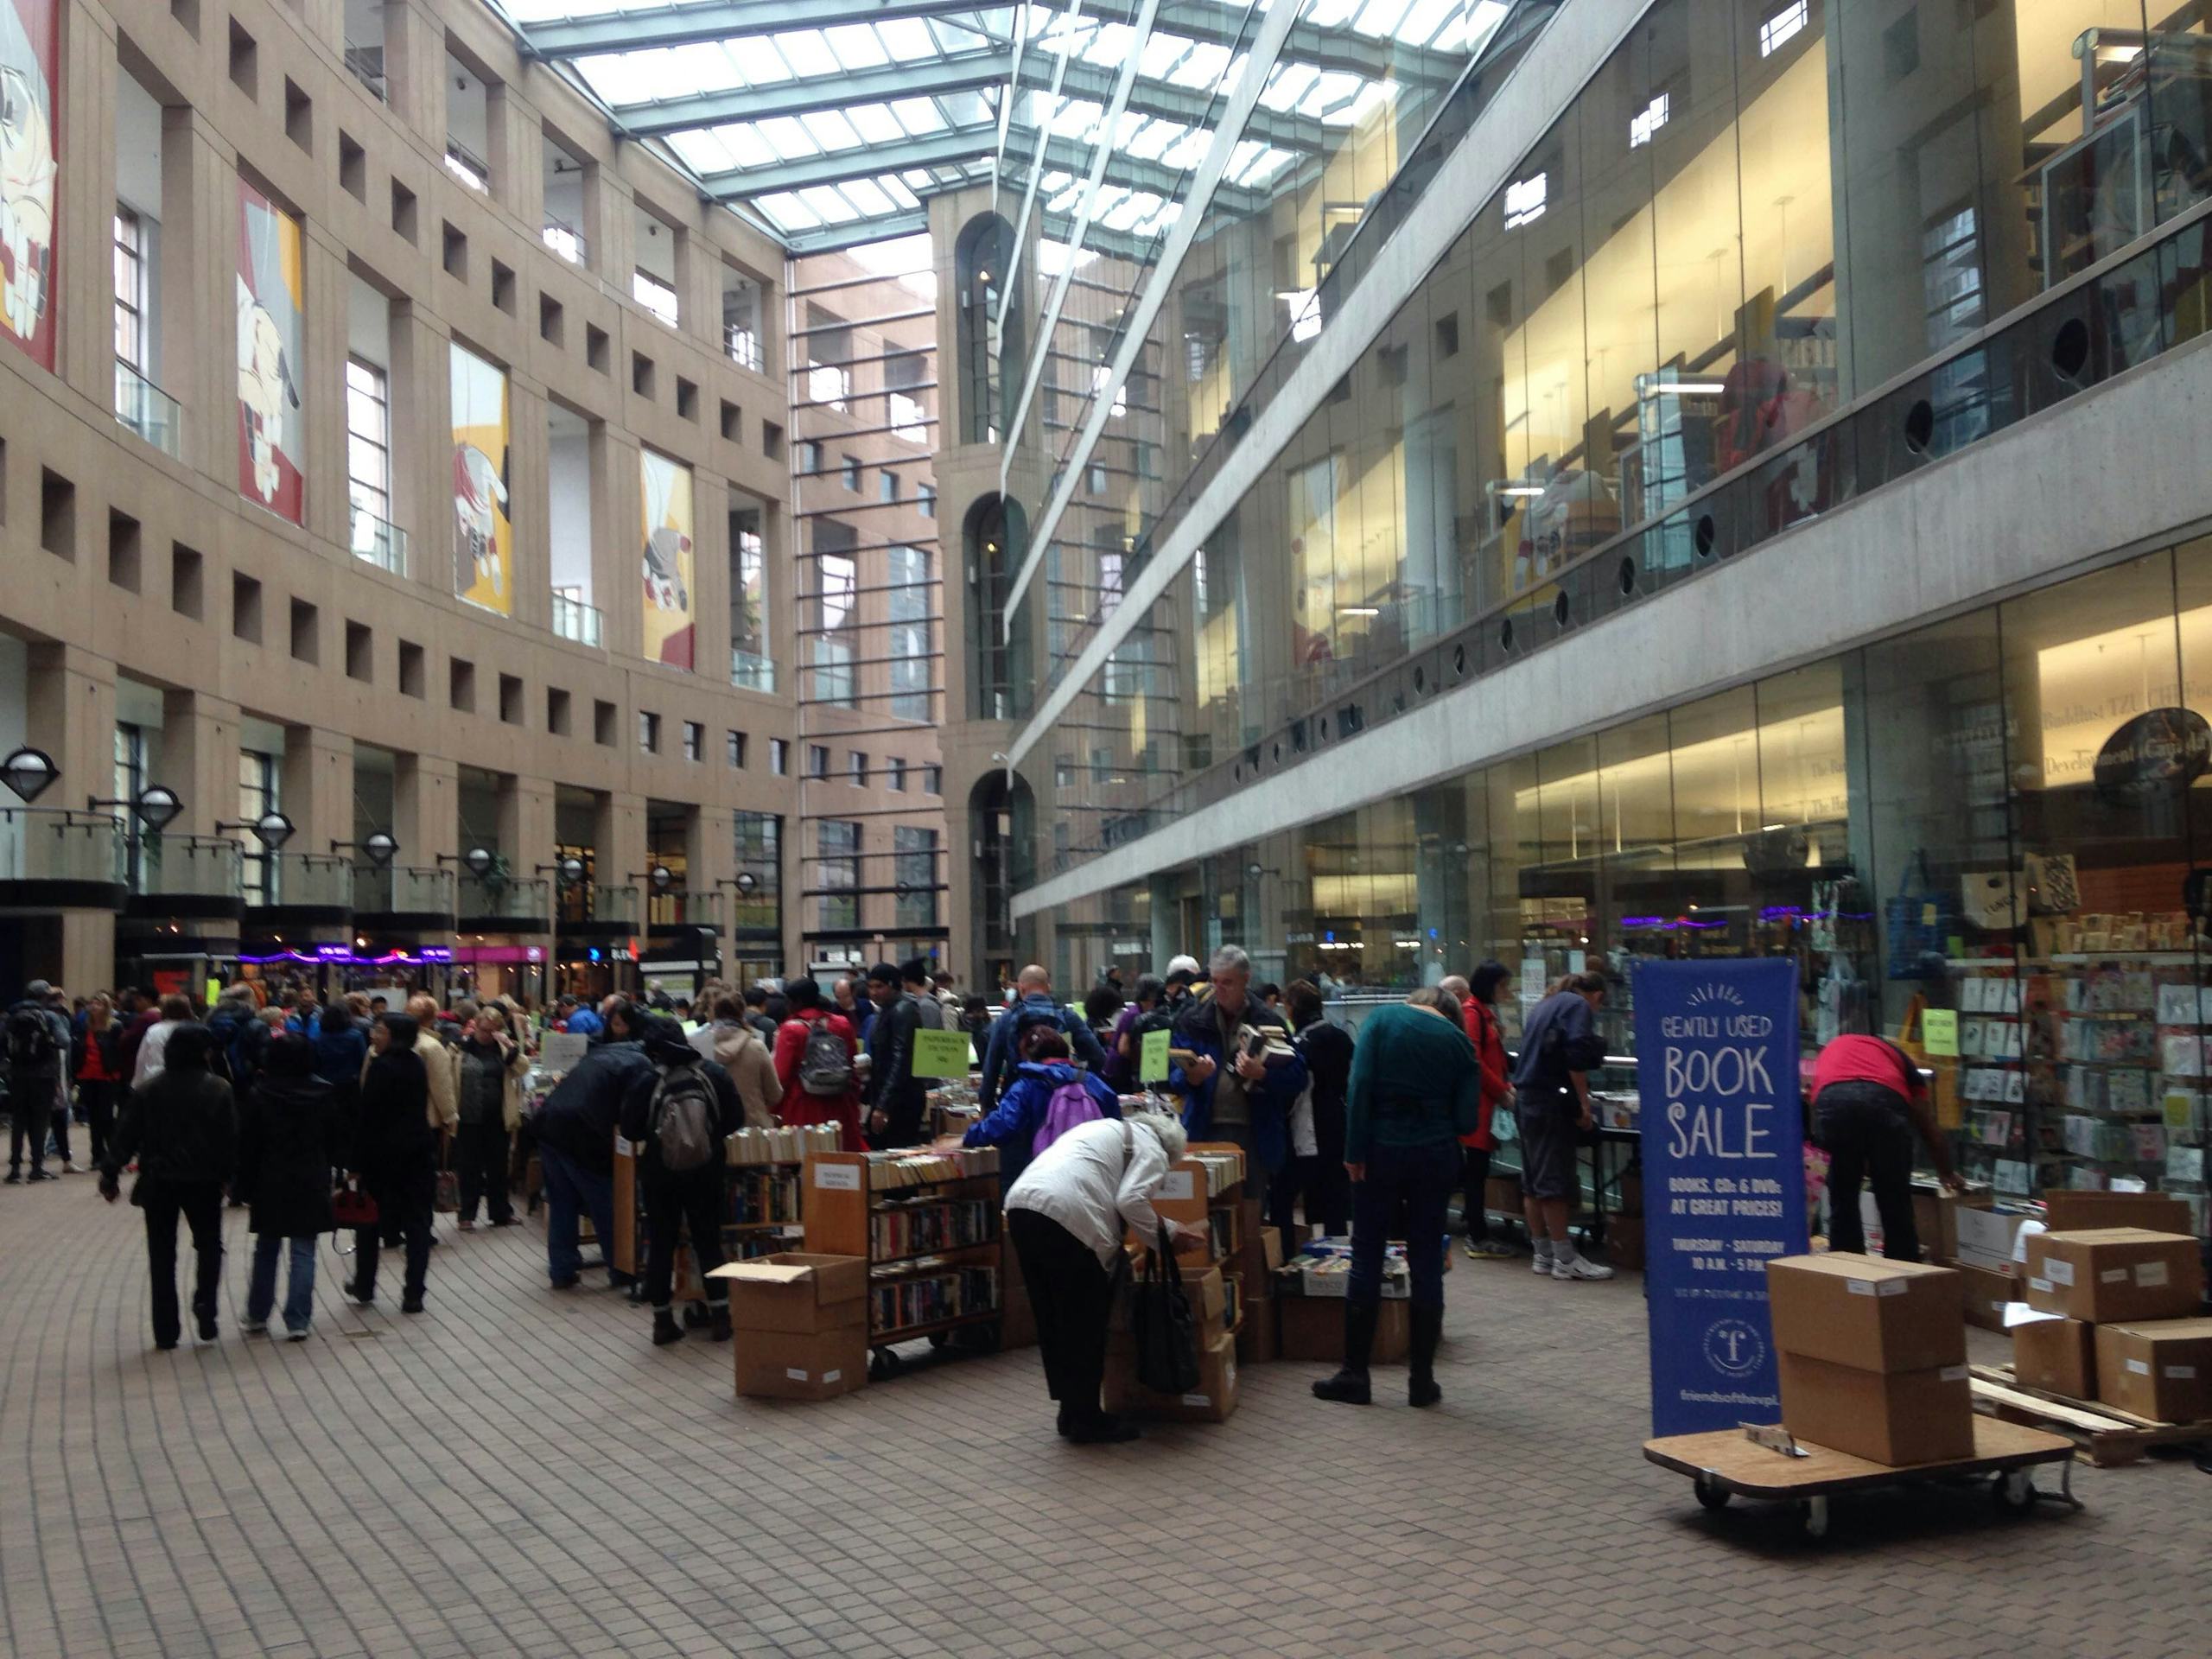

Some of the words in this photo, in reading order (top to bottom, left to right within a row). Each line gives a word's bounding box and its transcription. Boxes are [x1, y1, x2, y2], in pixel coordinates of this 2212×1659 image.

[1662, 1016, 1718, 1038] GENTLY
[1726, 1015, 1773, 1037] USED
[1665, 1046, 1775, 1098] BOOK
[1667, 1103, 1778, 1159] SALE
[1739, 1179, 1749, 1193] &
[1671, 1198, 1687, 1215] AT
[1689, 1198, 1729, 1216] GREAT
[1732, 1199, 1783, 1217] PRICES!
[1732, 1239, 1785, 1254] SATURDAY
[1680, 1389, 1780, 1408] friendsofthevpl.
